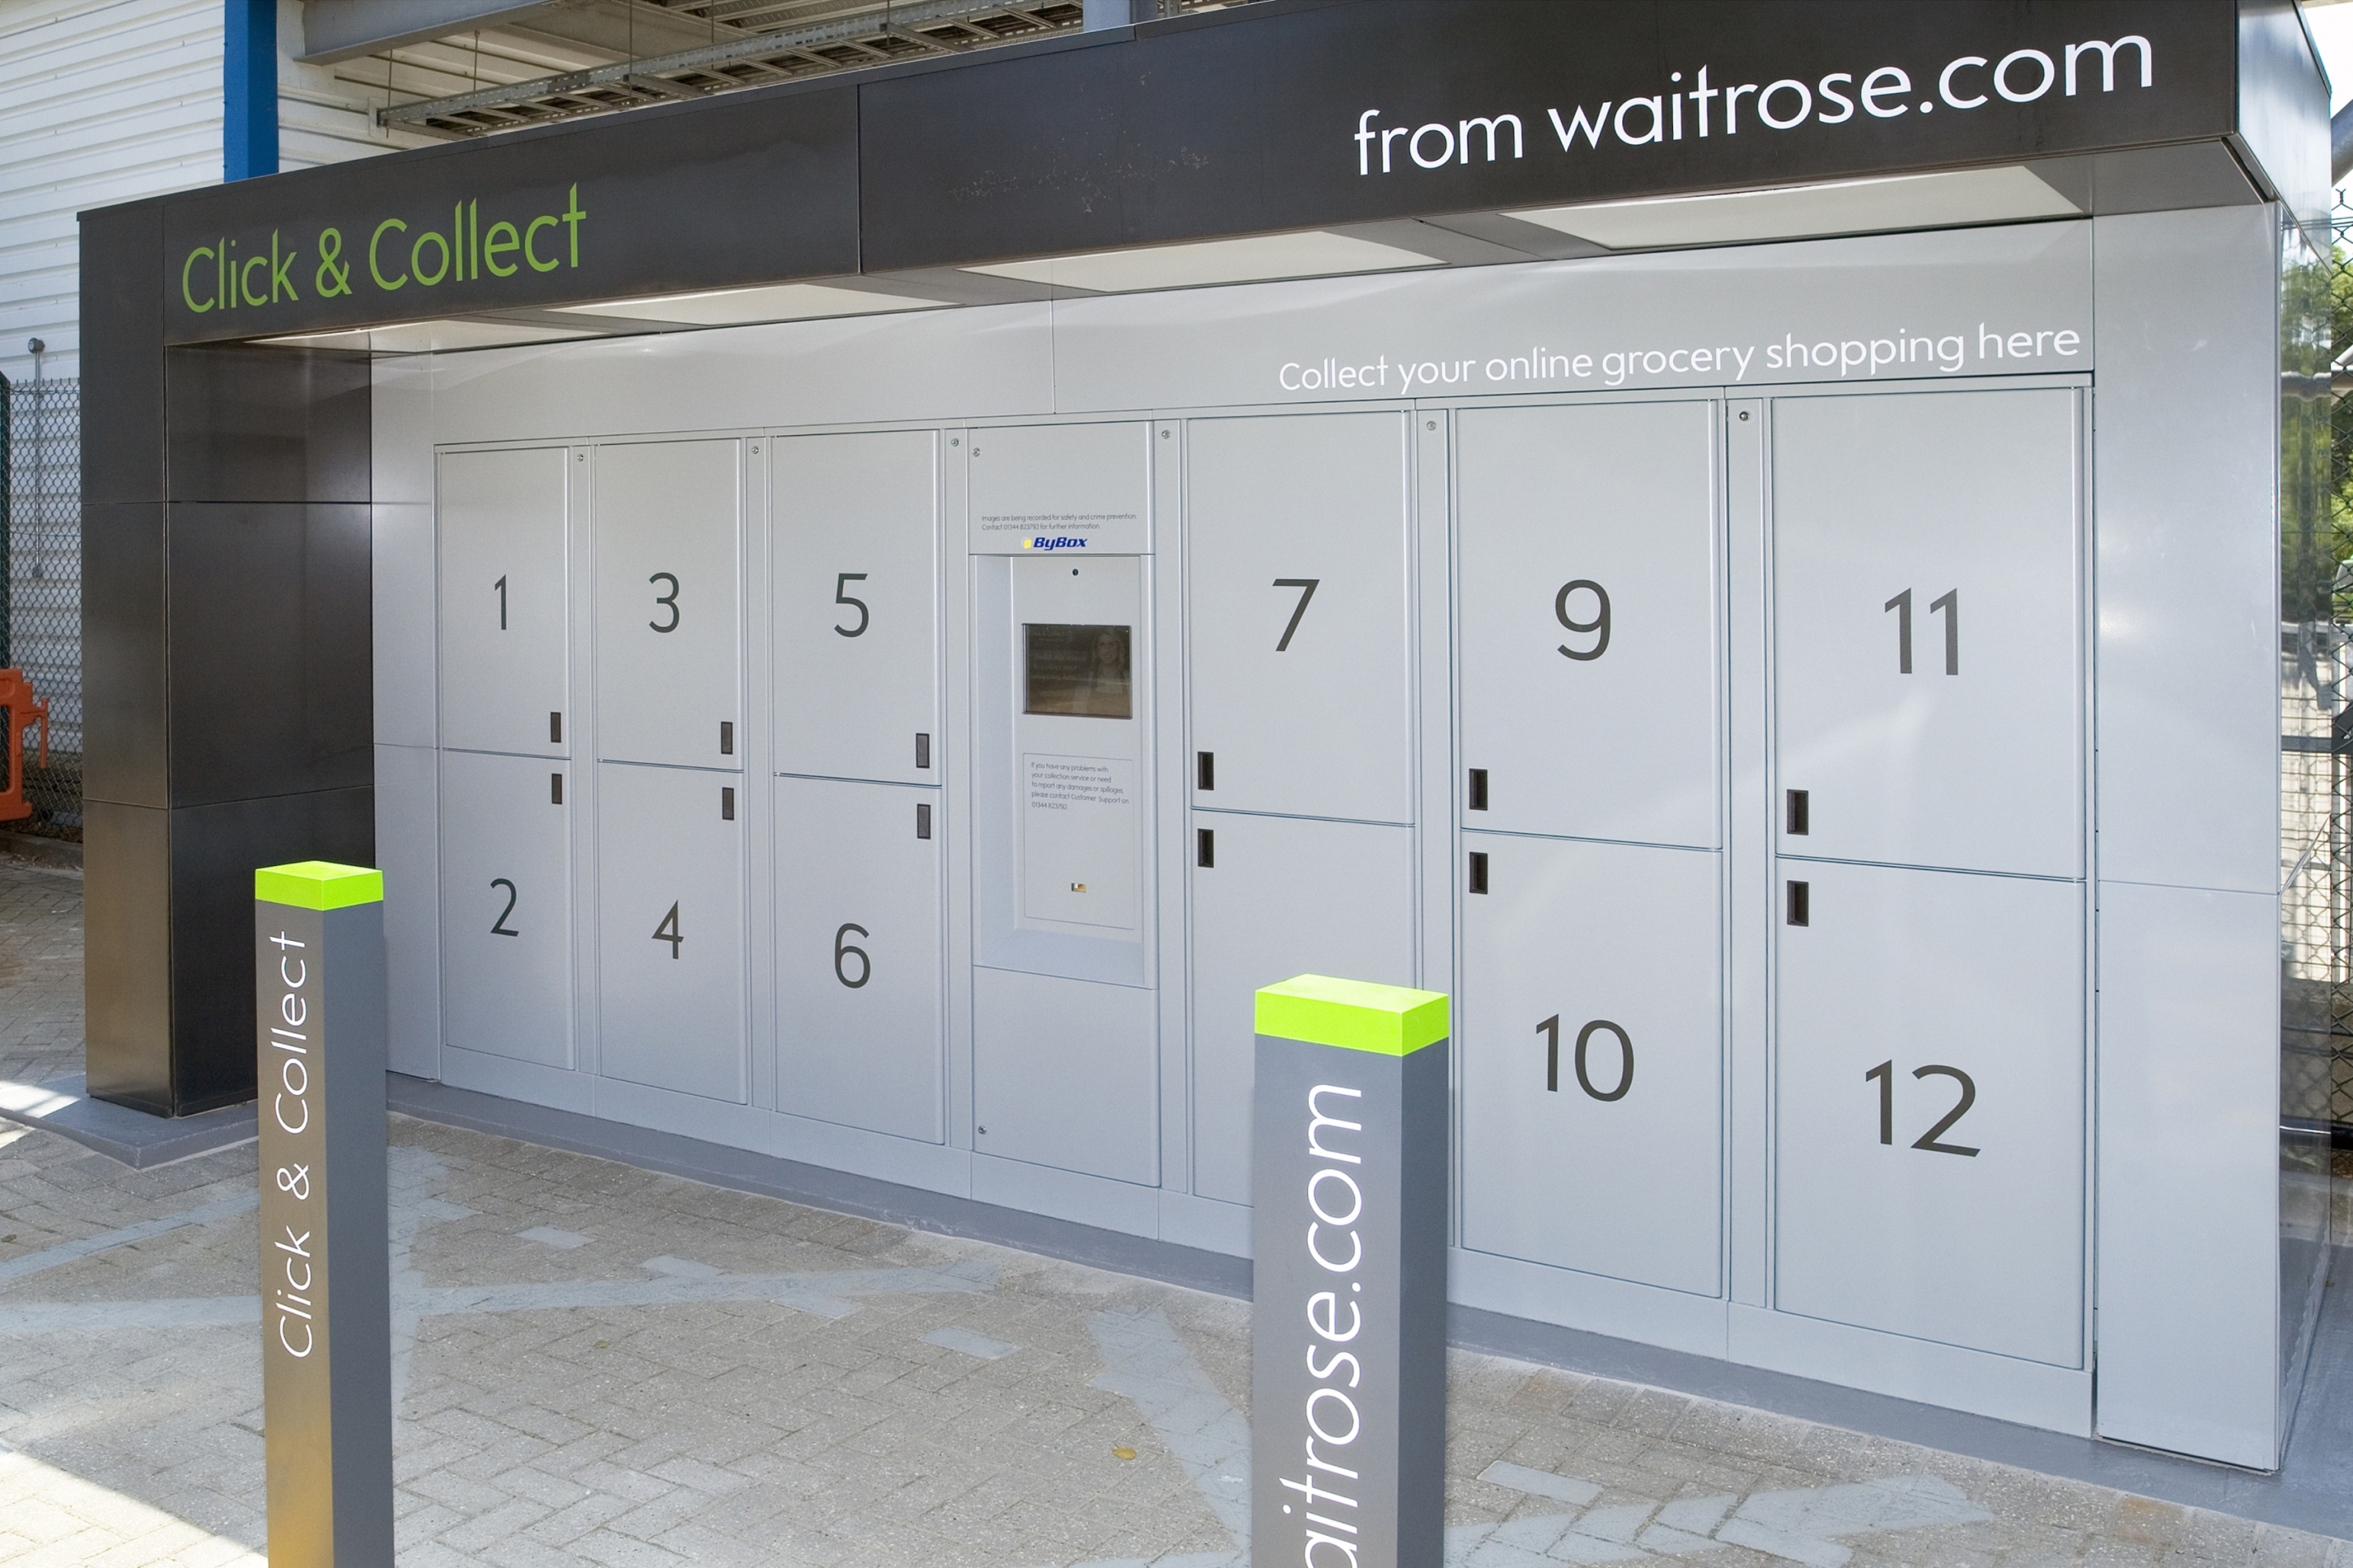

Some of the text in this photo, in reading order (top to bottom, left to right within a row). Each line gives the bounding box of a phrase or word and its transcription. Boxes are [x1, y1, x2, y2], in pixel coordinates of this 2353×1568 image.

[1354, 35, 2152, 175] from waitrose.com
[182, 182, 587, 313] Click & Collect
[1279, 322, 2081, 395] Collect your online grocery shopping here
[1033, 536, 1088, 550] ByBox
[1061, 514, 1078, 522] safety
[494, 574, 507, 631] 1
[649, 571, 680, 633] 3
[834, 572, 869, 638] 5
[1272, 578, 1321, 652] 7
[1555, 579, 1611, 662] 9
[1885, 588, 1959, 676] 11
[1067, 784, 1092, 793] damages
[1099, 796, 1120, 804] Support
[489, 877, 520, 938] 2
[651, 900, 684, 960] 4
[834, 922, 871, 989] 6
[1536, 1013, 1634, 1103] 10
[1865, 1059, 1981, 1157] 12
[269, 931, 313, 1358] Click & Collect
